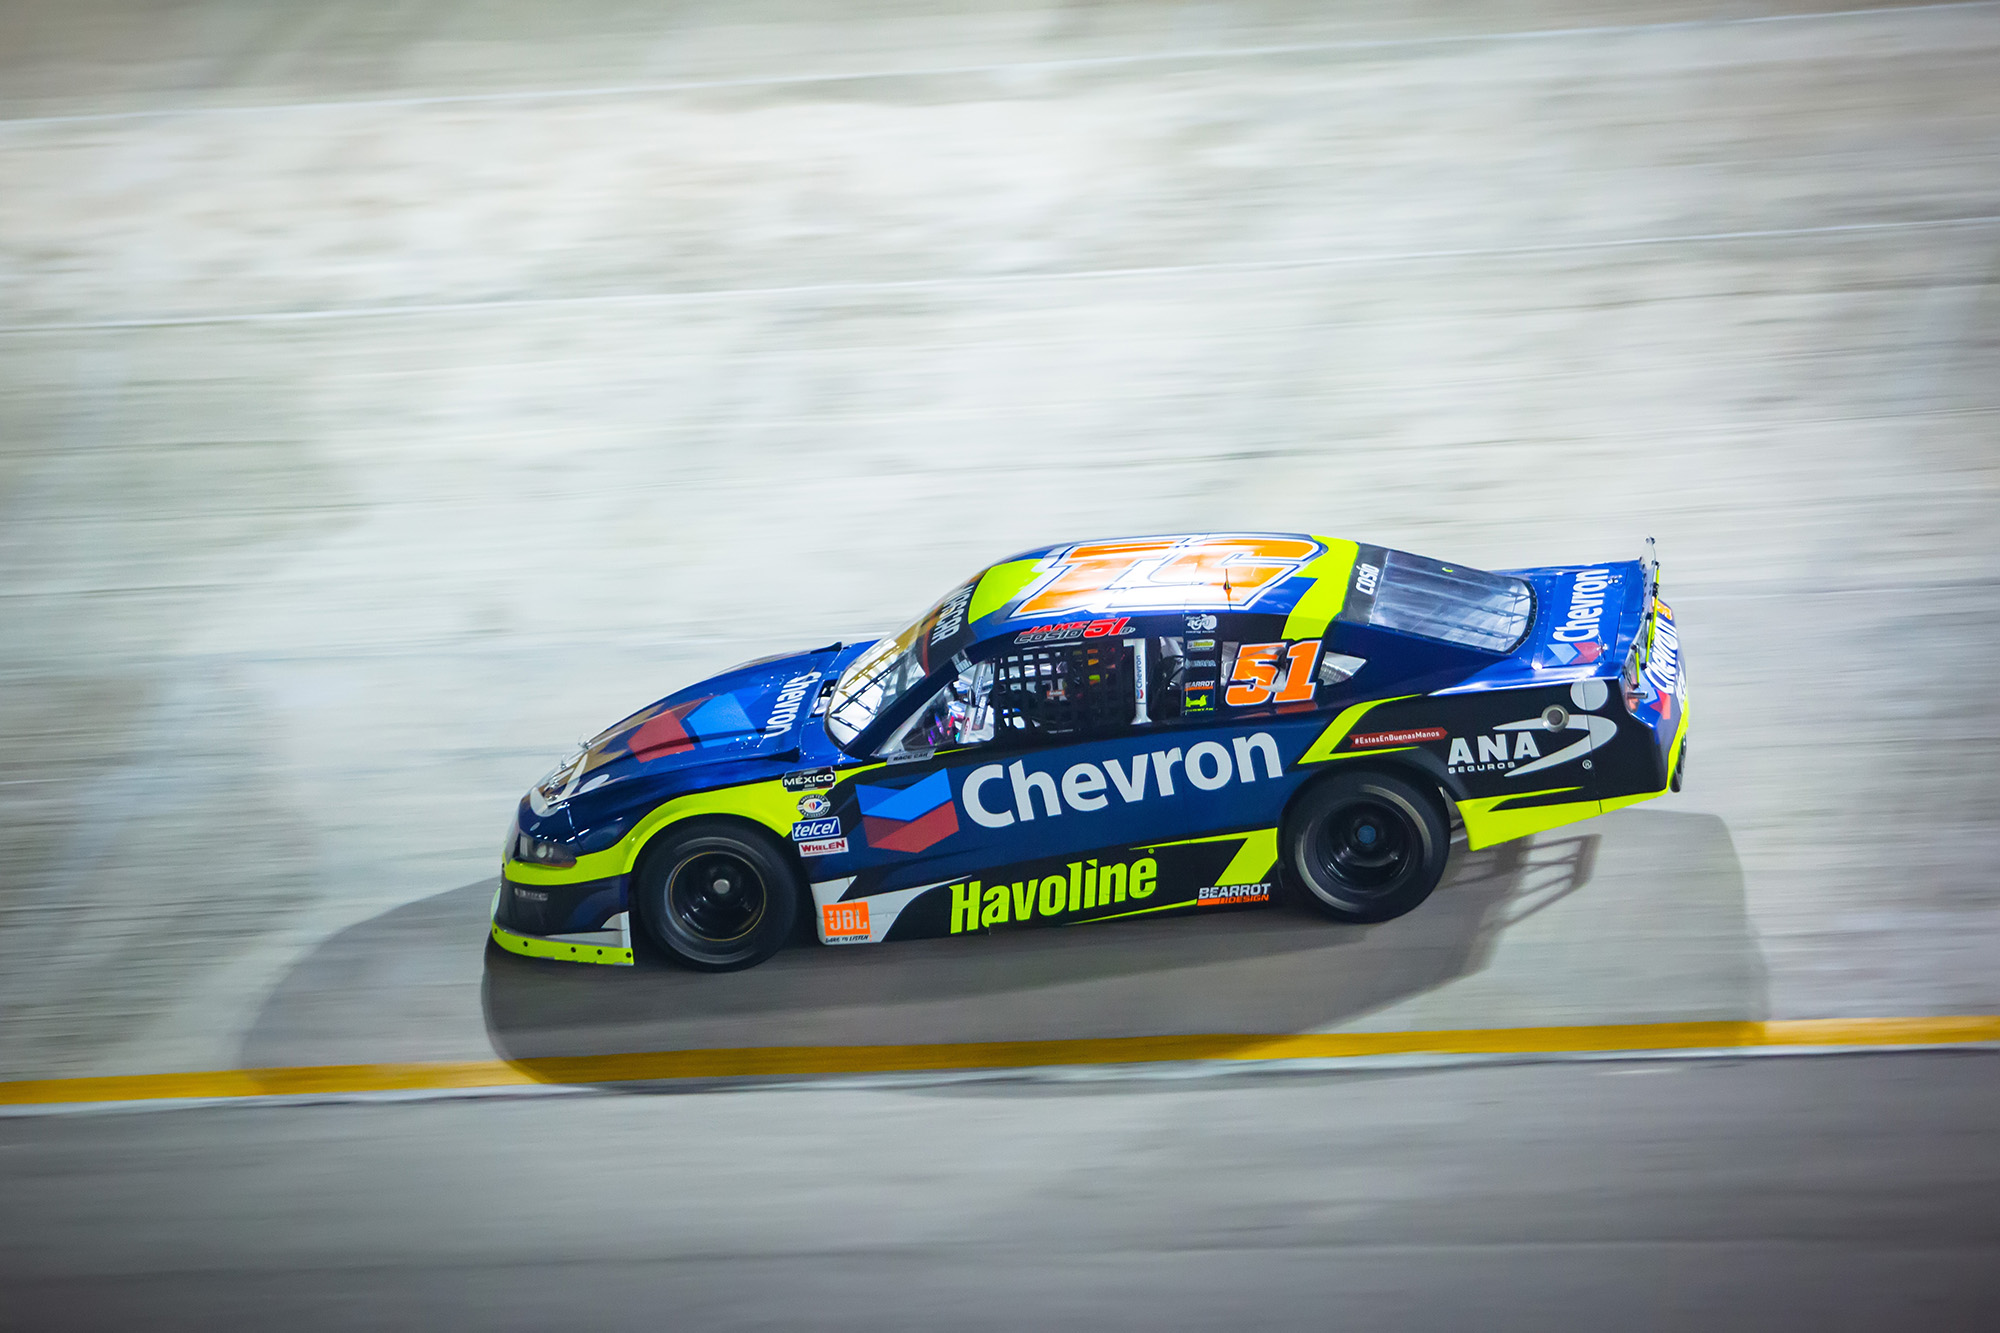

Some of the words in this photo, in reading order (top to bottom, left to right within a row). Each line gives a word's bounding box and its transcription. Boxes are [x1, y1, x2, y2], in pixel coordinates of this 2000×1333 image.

[1553, 569, 1609, 642] Chevron
[1020, 621, 1090, 635] JAKE
[1083, 617, 1131, 638] 51
[1645, 616, 1678, 694] Chevron
[1225, 640, 1322, 706] 51
[764, 672, 822, 739] Chevron
[1354, 730, 1440, 745] #EstasEnBuenasManos
[1447, 731, 1541, 765] ANA
[1448, 761, 1515, 774] SEGUROS
[784, 773, 834, 786] MÉXICO
[962, 731, 1284, 828] Chevron
[794, 820, 837, 838] telcel
[949, 857, 1157, 934] Havoline
[1198, 883, 1271, 899] BEARROT
[828, 909, 867, 931] JBL
